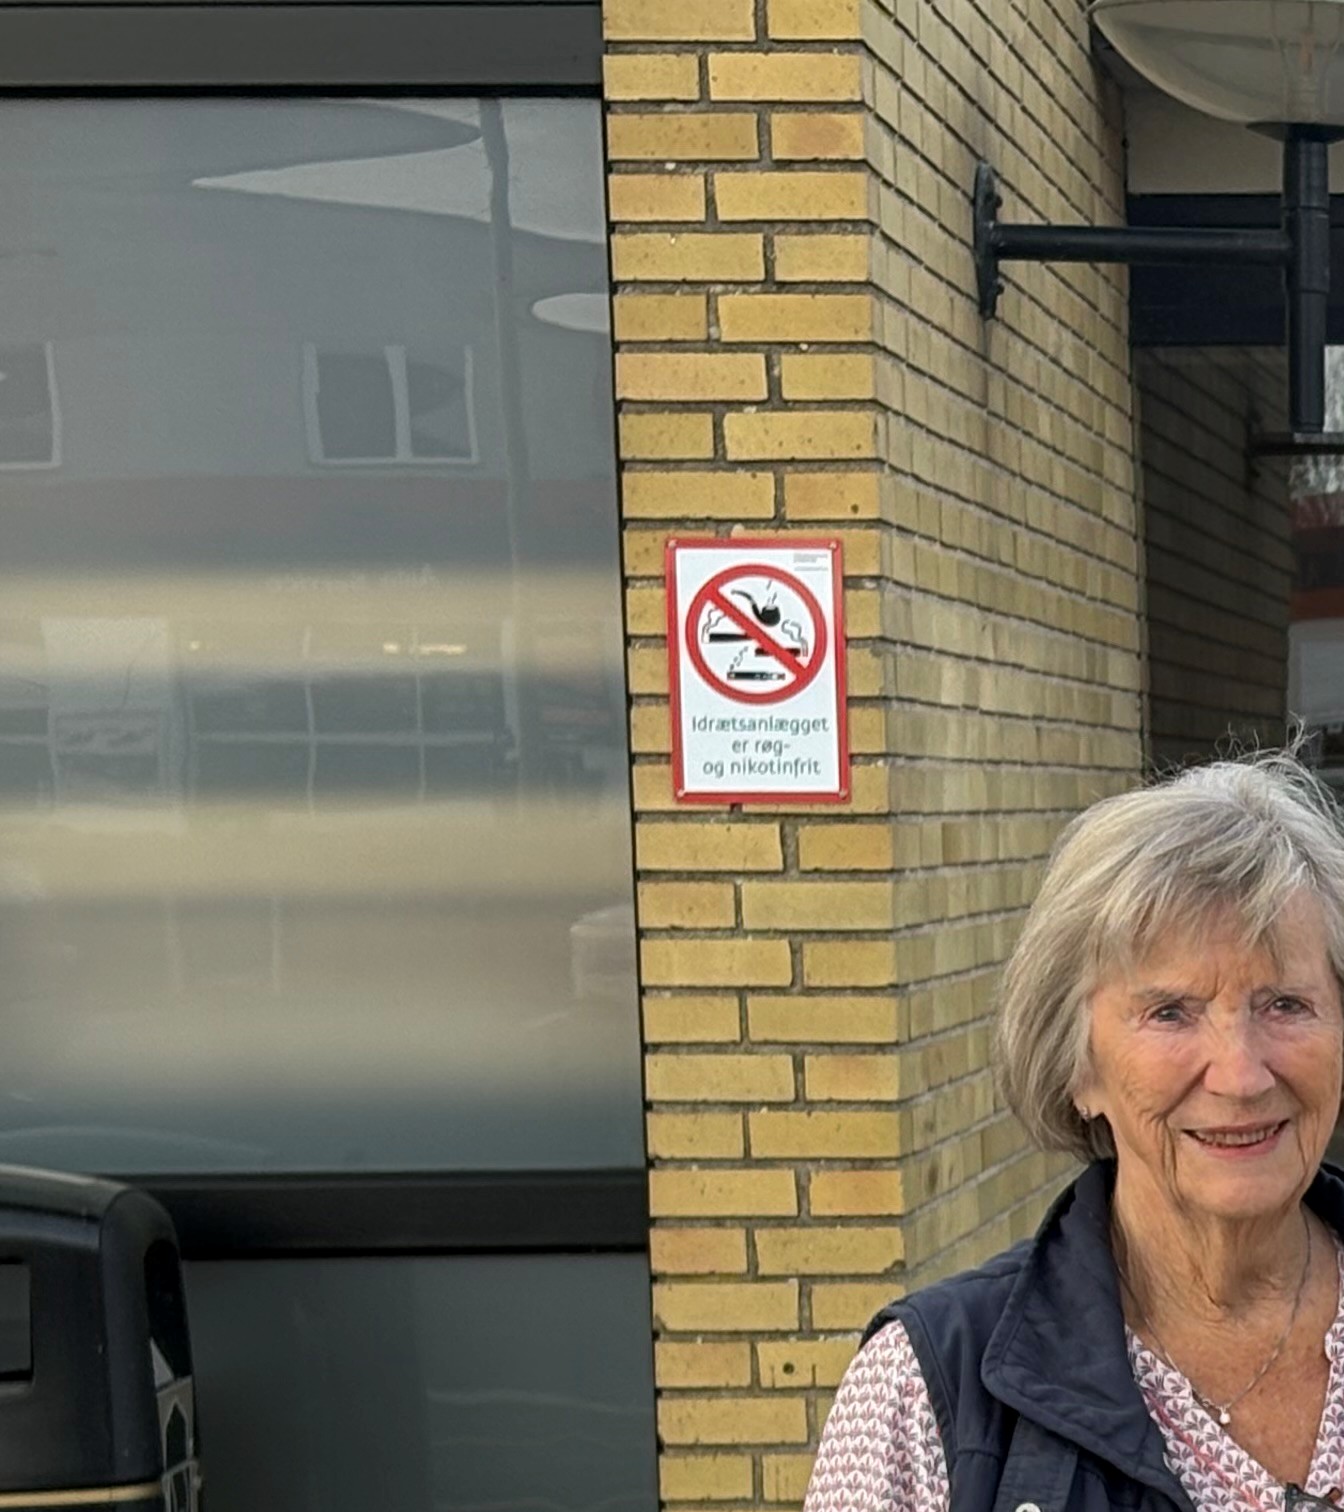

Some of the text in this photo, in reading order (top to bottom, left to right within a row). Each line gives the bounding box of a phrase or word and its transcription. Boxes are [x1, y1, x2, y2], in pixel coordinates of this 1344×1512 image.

[692, 716, 829, 735] Idrætsanlægget
[731, 740, 791, 757] er røg-
[703, 758, 821, 778] og nikotinfrit
